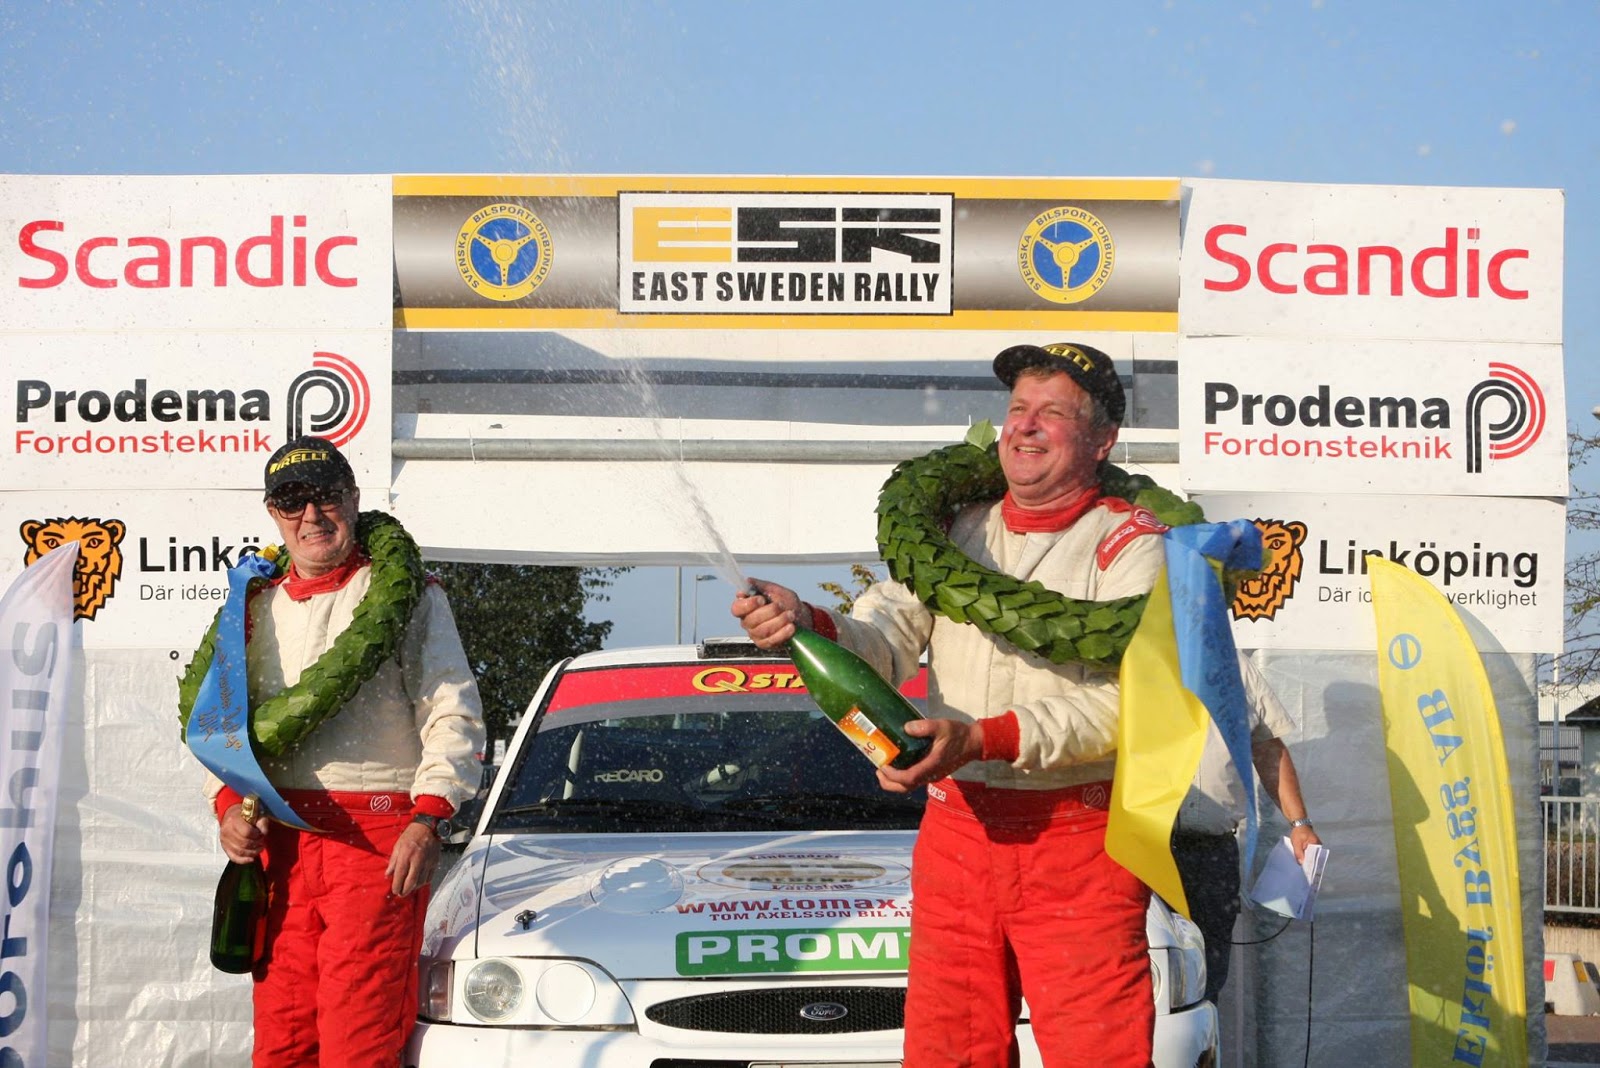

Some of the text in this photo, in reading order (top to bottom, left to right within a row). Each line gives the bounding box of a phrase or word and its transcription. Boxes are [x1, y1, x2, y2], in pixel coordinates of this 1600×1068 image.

[18, 215, 358, 288] Scandic
[458, 205, 551, 289] SVENSKA BILSPORTFÖRBUNDET
[1020, 209, 1112, 291] SVENSKA BILSPORTFÖRBUNDET
[1203, 224, 1529, 299] Scandic
[632, 272, 940, 301] EAST SWEDEN RALLY
[16, 379, 270, 423] Prodema
[1203, 382, 1451, 429] Prodema
[15, 430, 272, 454] Fordonsteknik
[1204, 432, 1452, 459] Fordonsteknik
[1319, 540, 1538, 588] Linköping
[140, 584, 174, 600] Där
[1318, 586, 1351, 602] Där
[1446, 590, 1537, 609] verklighet
[594, 769, 663, 782] RECARO
[675, 898, 912, 914] www.tomax.
[709, 913, 749, 921] TOM
[756, 910, 851, 920] AXELSSON
[857, 910, 887, 918] BIL
[688, 932, 911, 964] PROM
